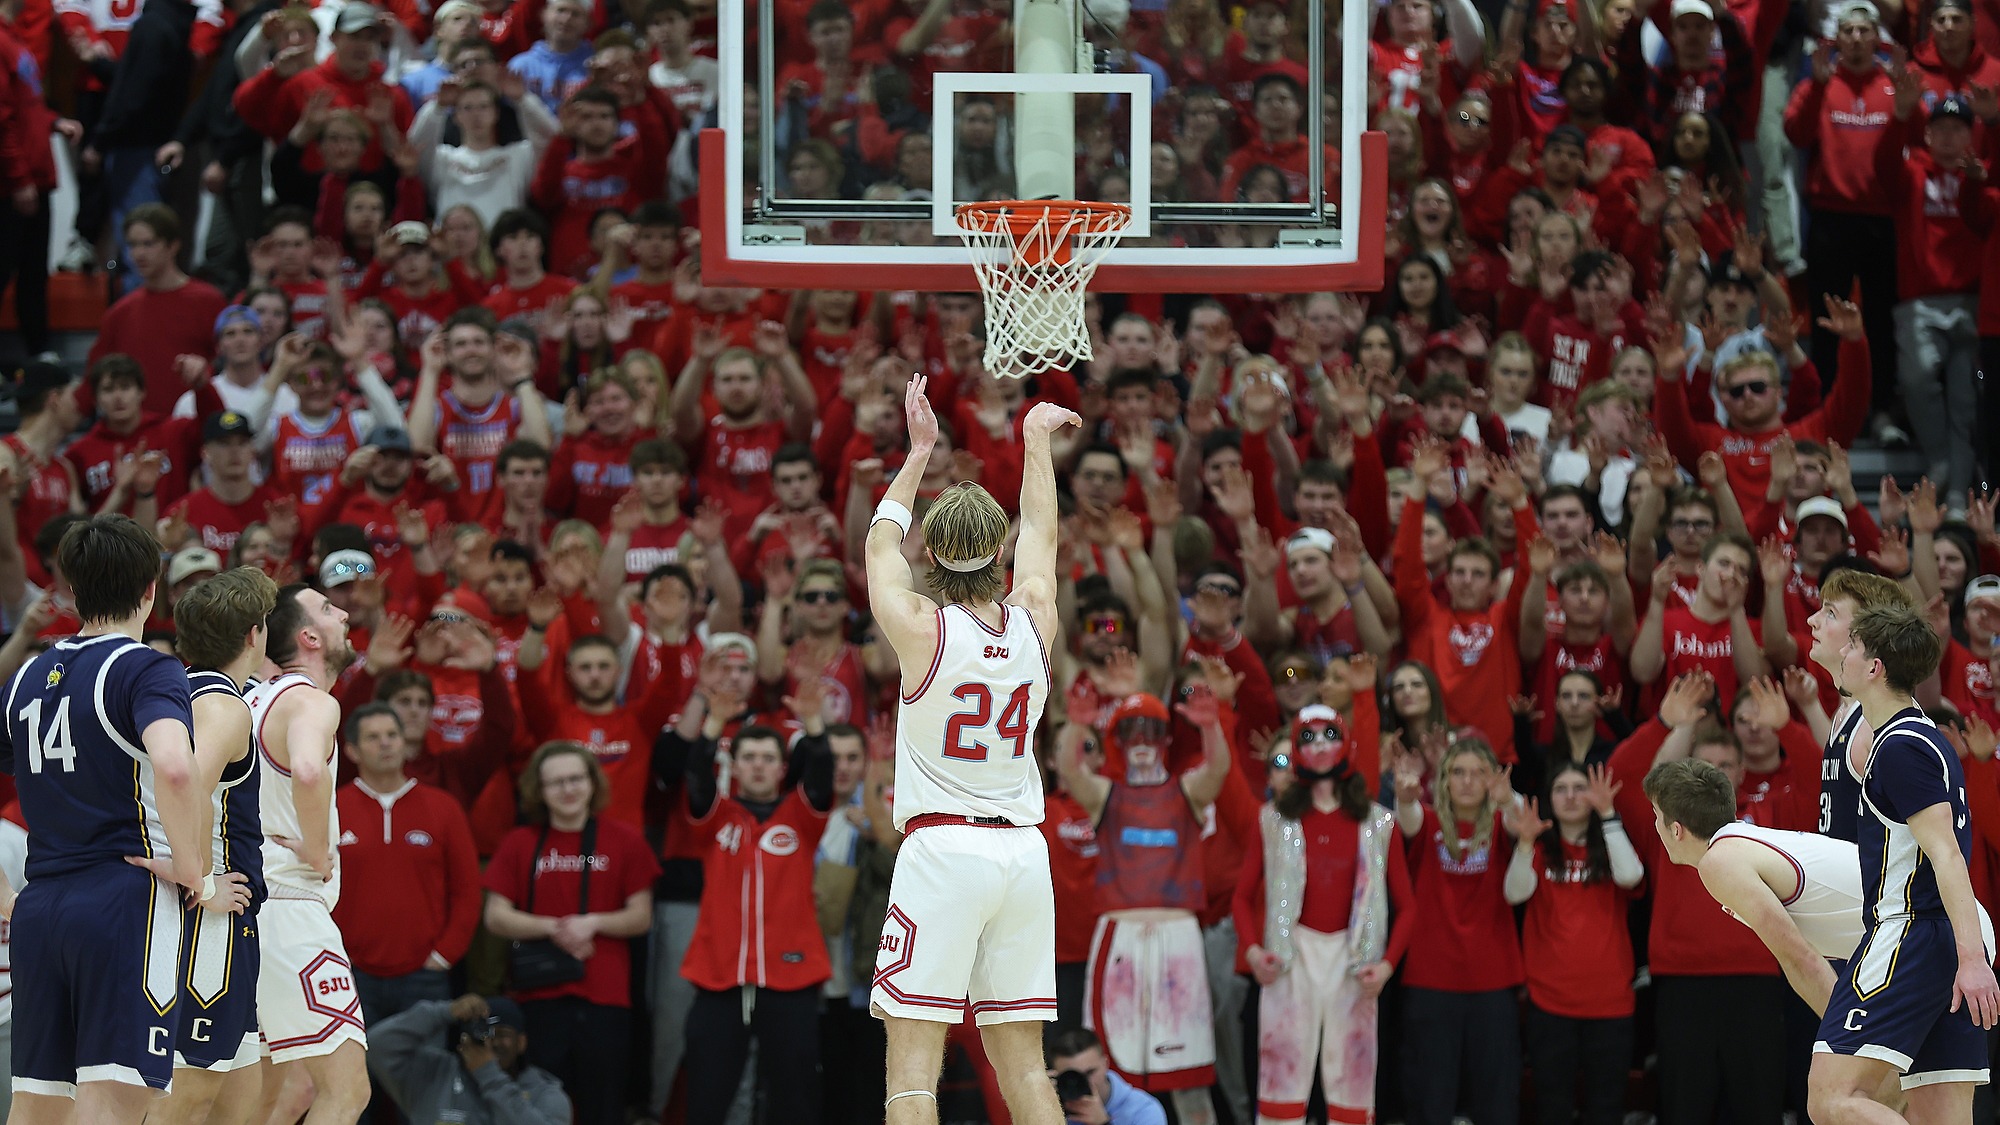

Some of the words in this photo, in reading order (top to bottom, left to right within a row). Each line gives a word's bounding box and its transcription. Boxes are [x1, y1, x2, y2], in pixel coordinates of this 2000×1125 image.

[983, 645, 1010, 660] SJU
[940, 680, 1033, 763] 24
[18, 695, 77, 774] 14
[319, 977, 351, 996] SJU
[191, 1017, 213, 1042] C
[1843, 1008, 1868, 1031] C
[148, 1026, 170, 1056] C
